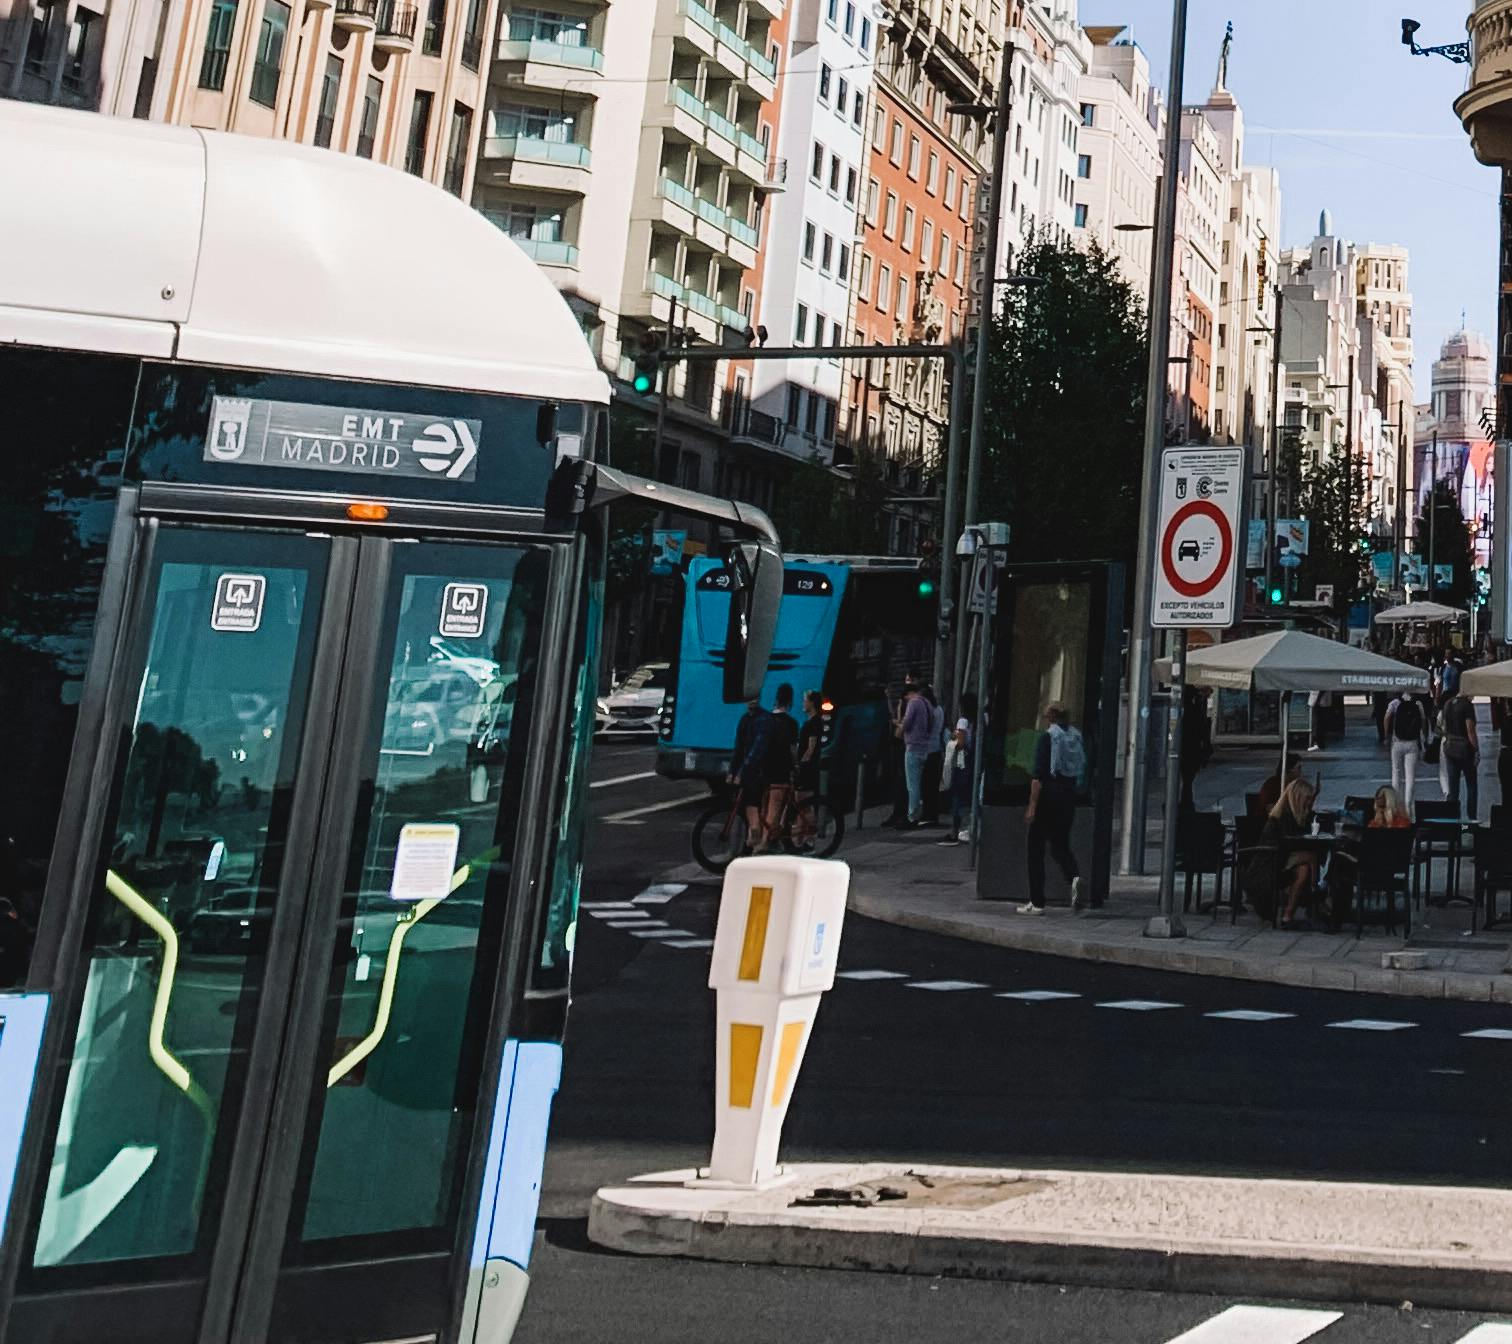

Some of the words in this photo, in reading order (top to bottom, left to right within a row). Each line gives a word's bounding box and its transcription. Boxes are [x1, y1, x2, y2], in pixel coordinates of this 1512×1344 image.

[341, 414, 405, 442] EMT
[280, 436, 401, 469] MADRID
[1160, 601, 1189, 610] EXCEPTO
[1341, 675, 1394, 686] STARBUCKS
